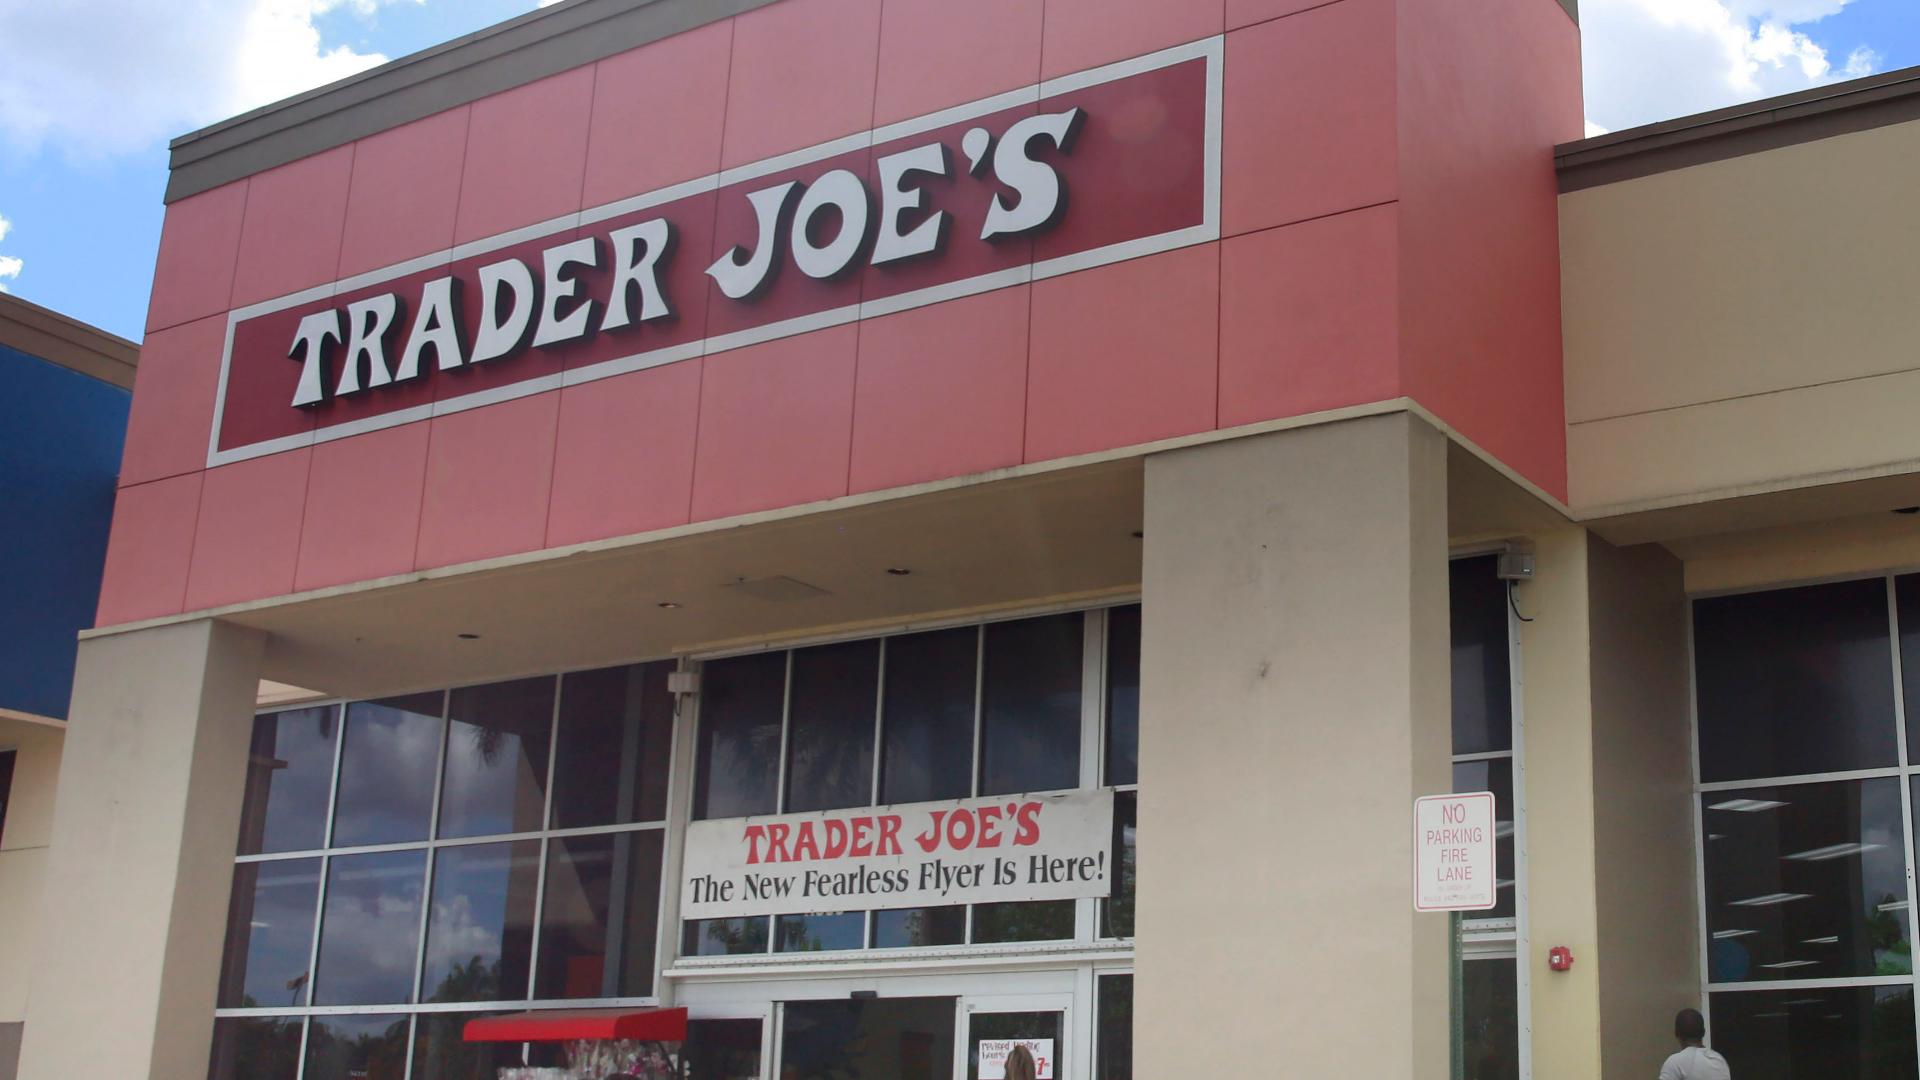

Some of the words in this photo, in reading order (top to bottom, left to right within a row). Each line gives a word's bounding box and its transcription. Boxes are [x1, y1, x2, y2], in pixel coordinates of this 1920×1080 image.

[288, 216, 672, 408] TRADER
[706, 106, 1082, 300] JOE'S
[1442, 803, 1466, 824] NO
[742, 814, 904, 865] TRADER
[915, 802, 1043, 853] JOE'S
[1427, 827, 1482, 846] PARKING
[1441, 848, 1469, 863] FIRE
[690, 874, 734, 904] The
[743, 873, 796, 901] New
[802, 864, 909, 898] Fearless
[919, 858, 985, 897] Flyer
[993, 856, 1017, 886] Is
[1027, 850, 1105, 884] Here!
[1437, 866, 1472, 882] LANE
